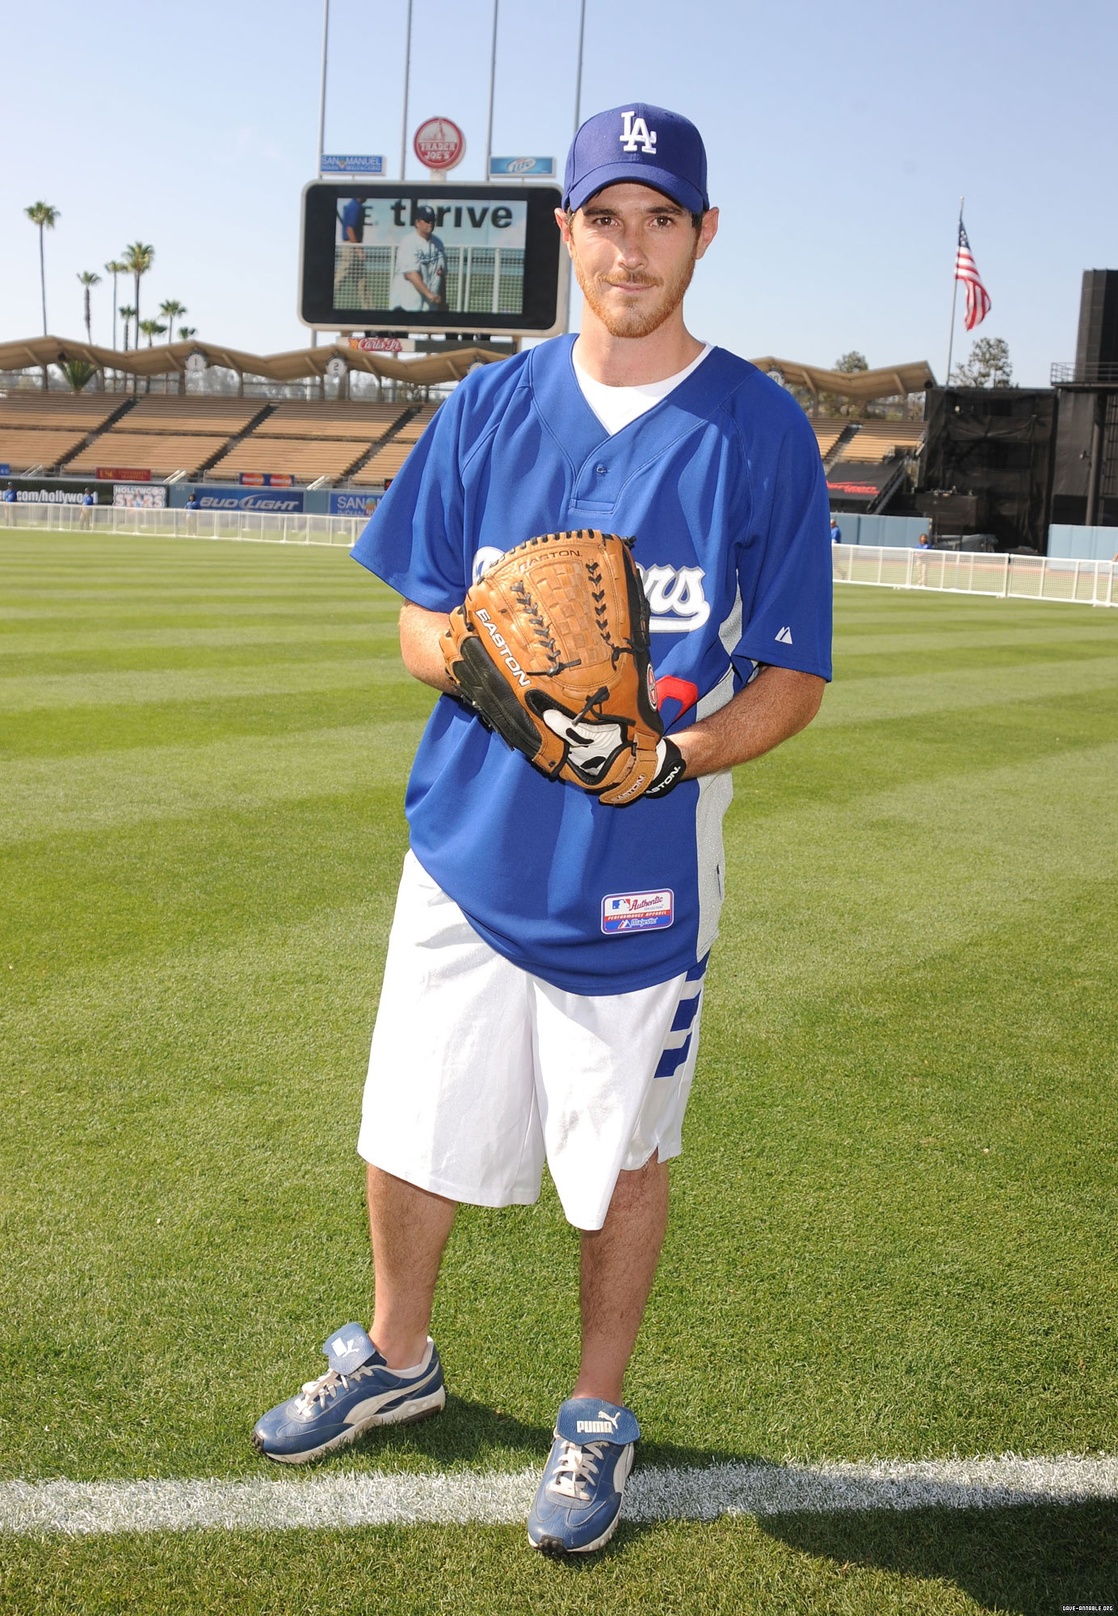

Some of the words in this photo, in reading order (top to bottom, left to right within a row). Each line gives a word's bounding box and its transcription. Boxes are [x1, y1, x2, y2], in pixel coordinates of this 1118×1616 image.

[620, 111, 657, 154] LA
[420, 142, 456, 151] TRADER
[321, 156, 338, 165] SAN
[346, 156, 381, 165] MANUEL
[424, 151, 450, 160] JOE'S
[200, 497, 237, 508] BUD
[248, 498, 299, 510] LIGHT
[337, 496, 365, 509] SAN
[475, 608, 532, 687] EASTON
[629, 896, 663, 911] Authentic
[577, 1421, 613, 1434] PUMA
